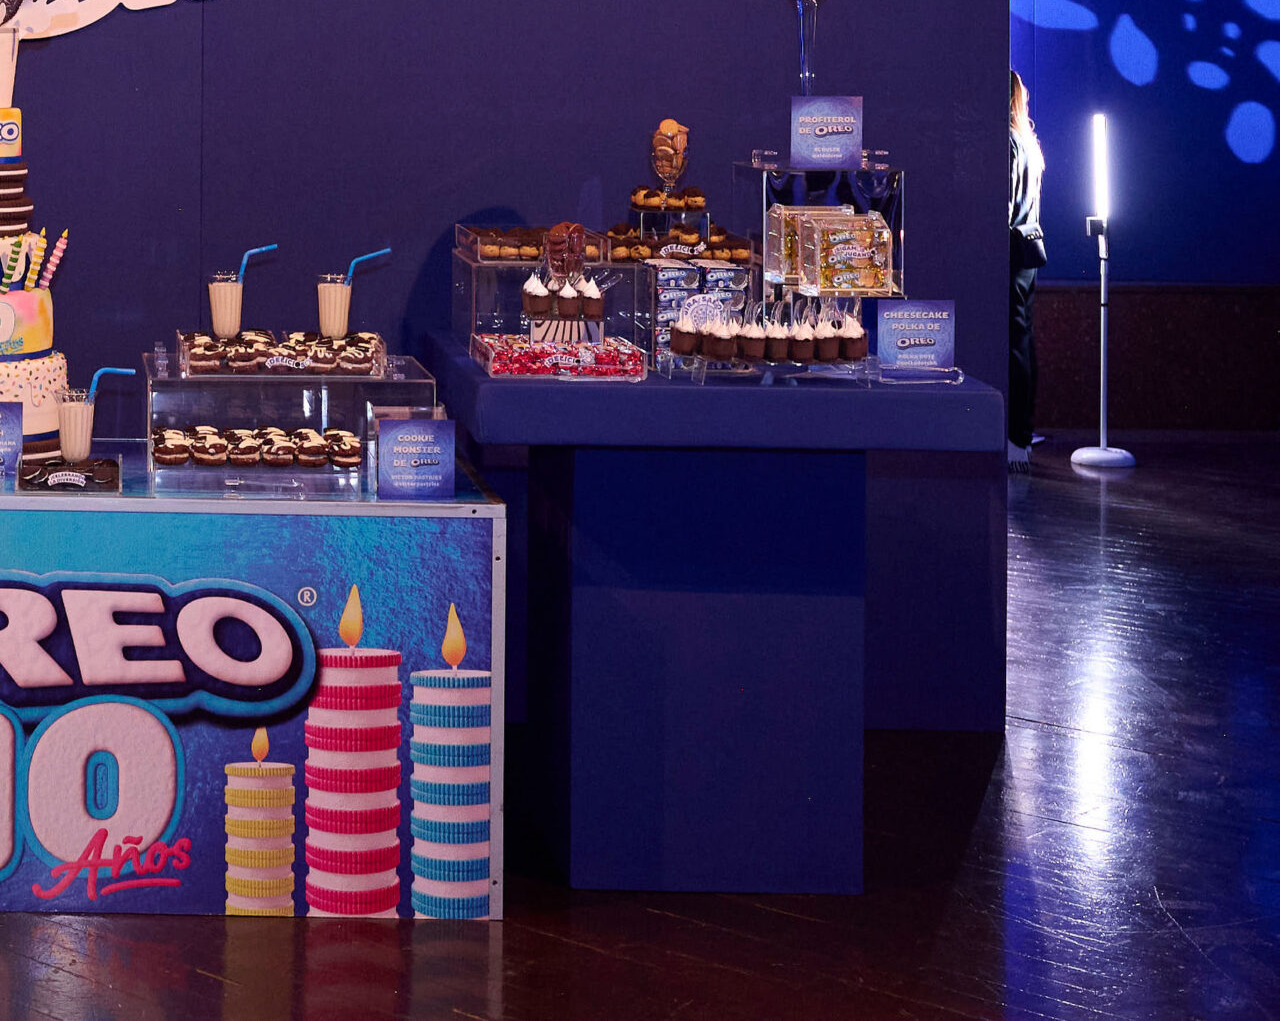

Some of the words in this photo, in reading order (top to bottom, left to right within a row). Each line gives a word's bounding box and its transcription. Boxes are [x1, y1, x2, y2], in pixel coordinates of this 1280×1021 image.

[815, 126, 852, 135] OREO
[897, 338, 934, 347] OREO
[398, 434, 434, 442] COOKIE
[32, 827, 193, 901] Años
